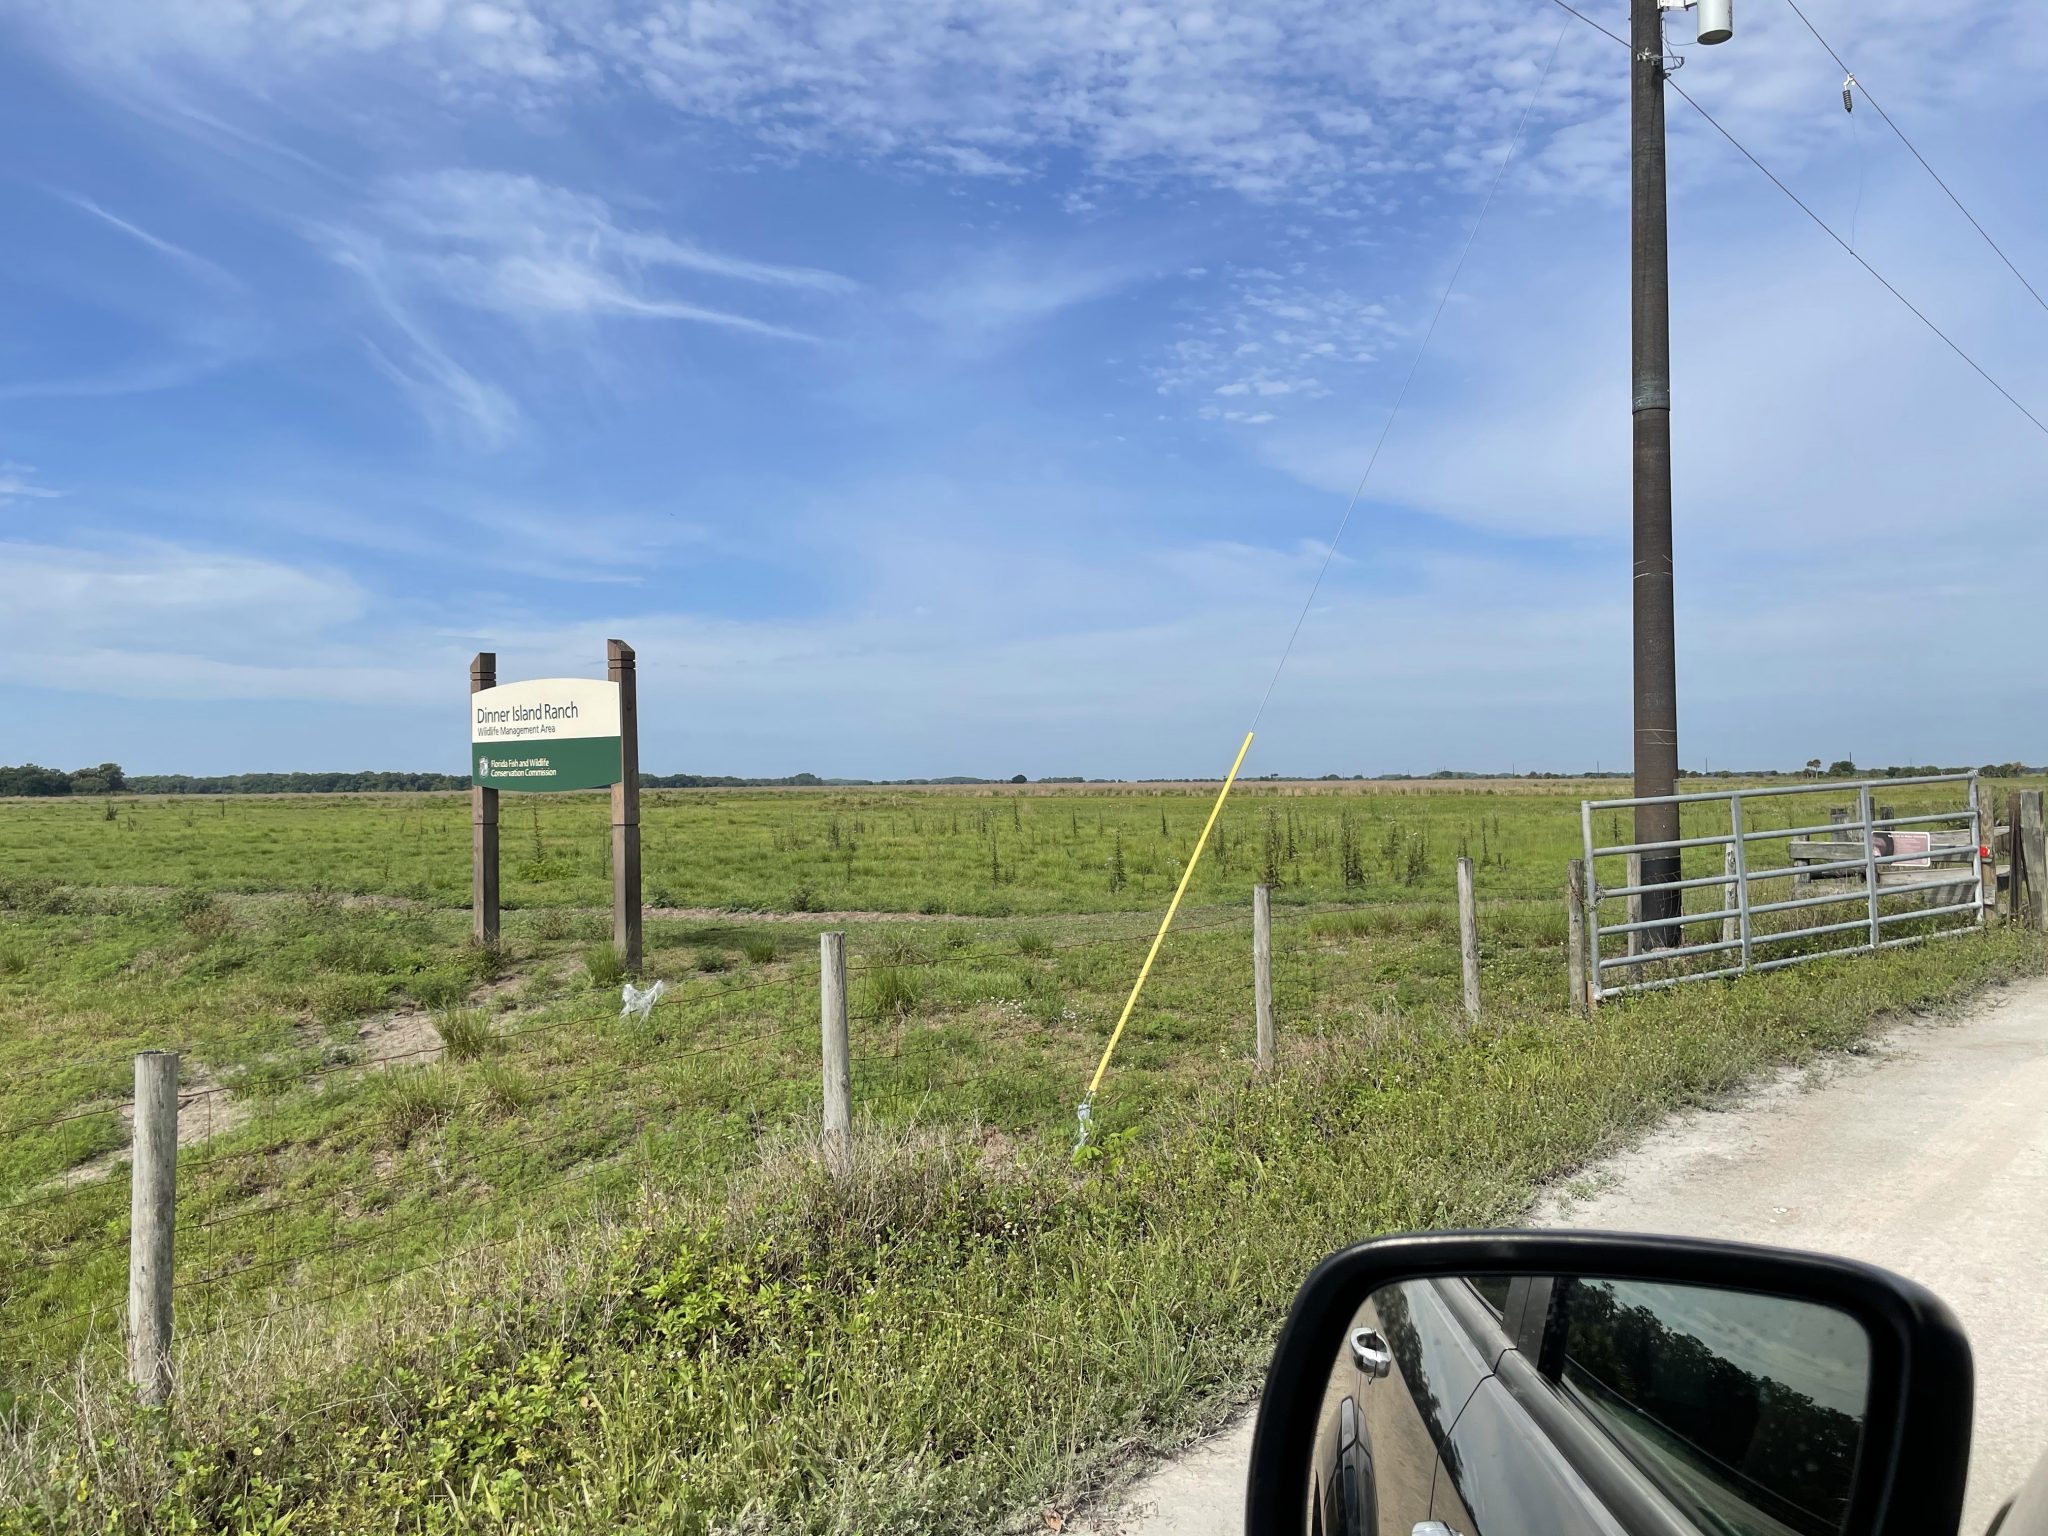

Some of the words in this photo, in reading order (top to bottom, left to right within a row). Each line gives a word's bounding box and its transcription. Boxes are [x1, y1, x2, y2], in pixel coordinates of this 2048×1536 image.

[477, 707, 510, 724] Dinner
[512, 703, 542, 722] Island
[544, 701, 578, 719] Ranch
[478, 726, 499, 736] Wildlife
[500, 725, 540, 737] Management
[540, 724, 556, 733] Area
[490, 759, 508, 768] Florida
[508, 759, 518, 768] Fish
[530, 758, 550, 767] Wildlife
[490, 769, 524, 778] Conservation
[524, 768, 556, 777] Commission
